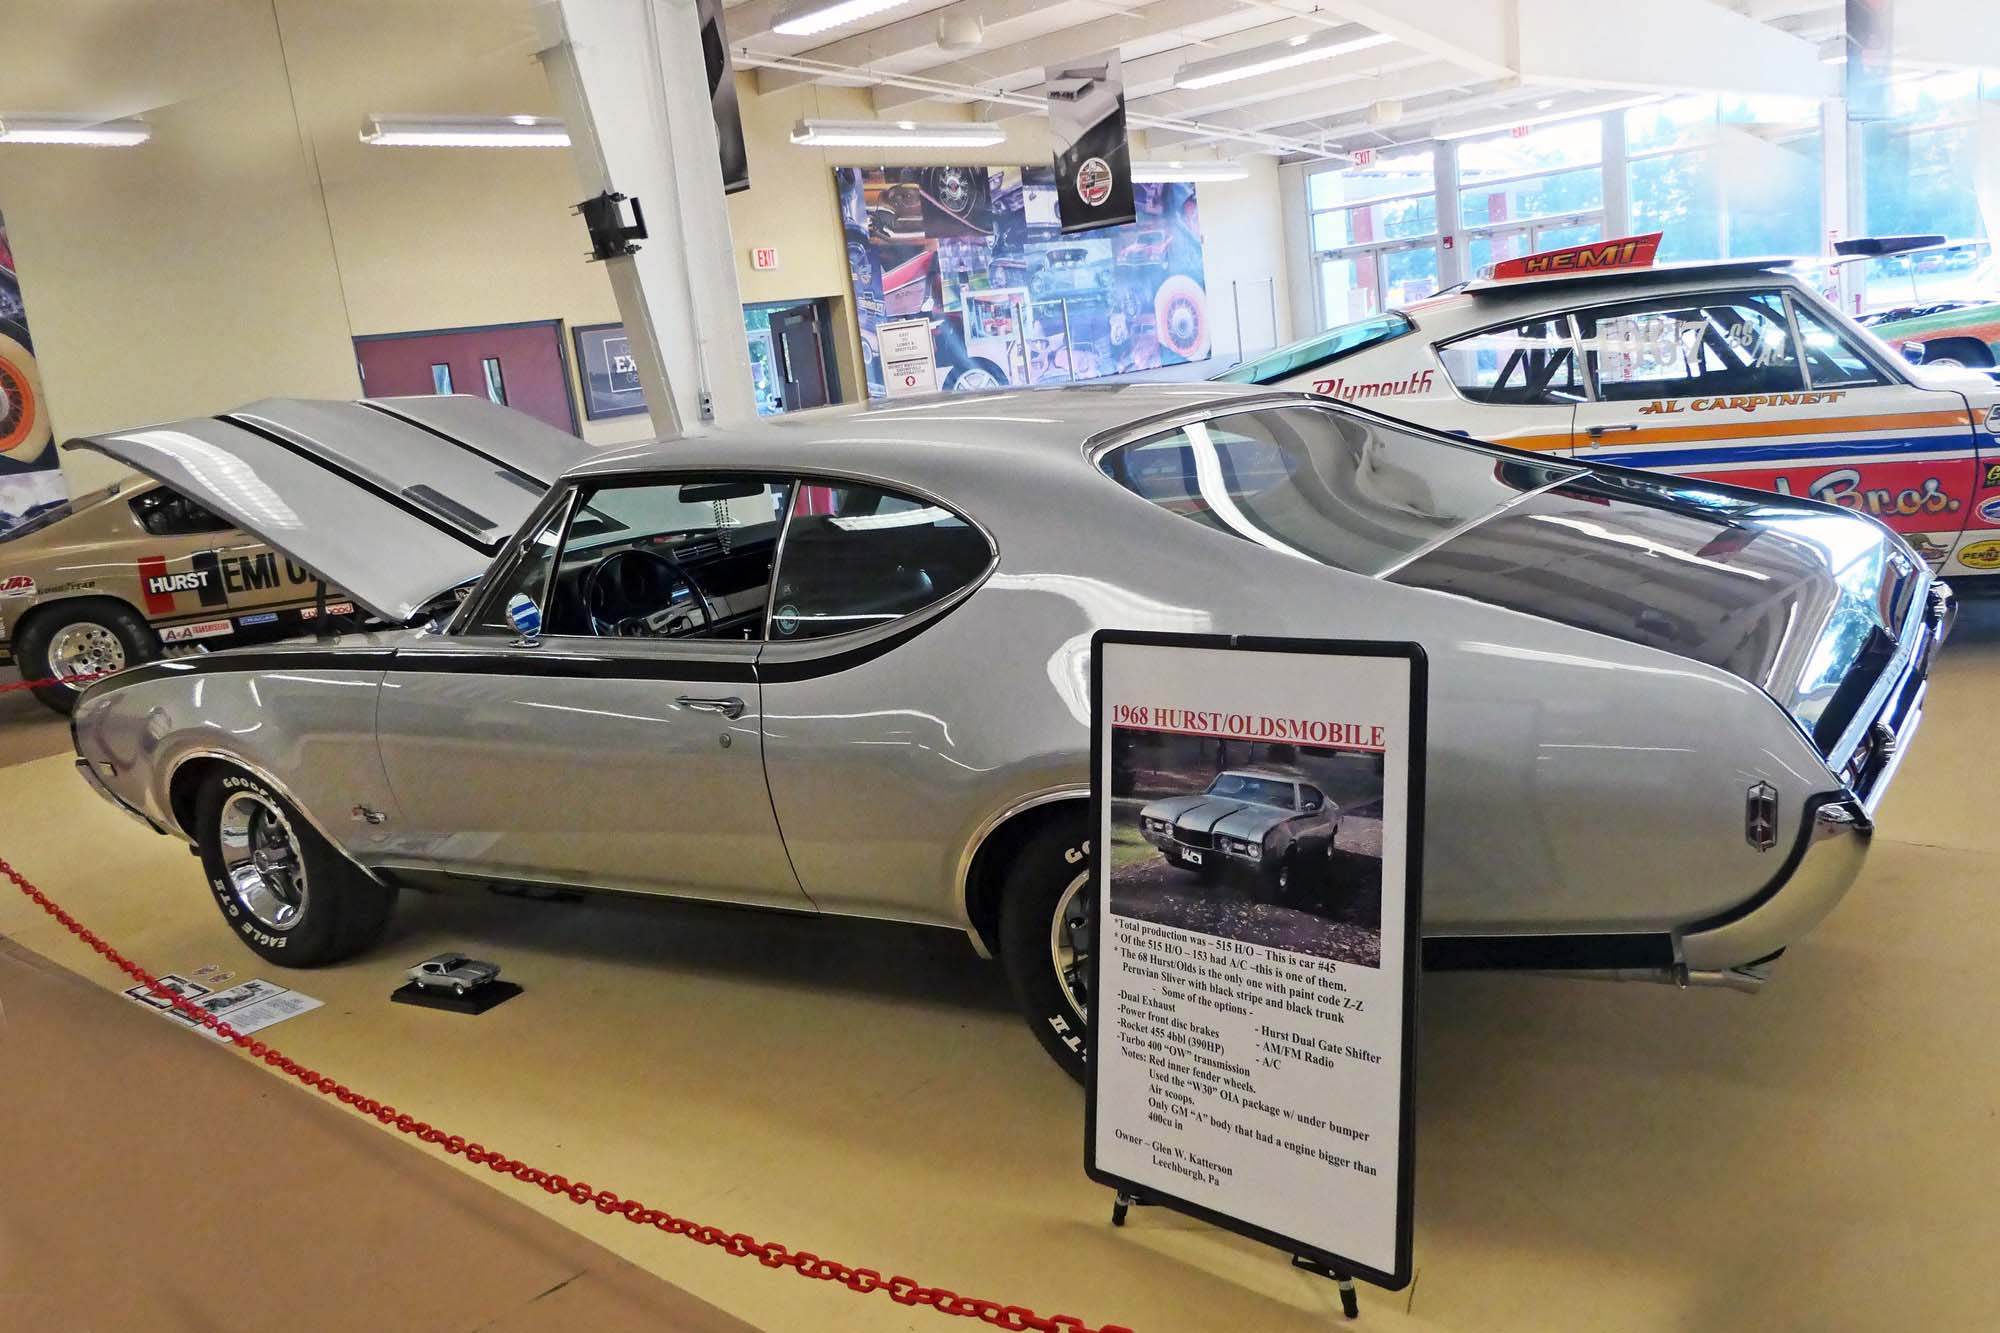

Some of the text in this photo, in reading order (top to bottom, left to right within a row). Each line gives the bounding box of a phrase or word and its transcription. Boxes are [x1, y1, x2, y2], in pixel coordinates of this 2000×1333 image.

[1354, 150, 1371, 167] EXIT
[757, 249, 775, 267] EXIT
[1312, 369, 1434, 401] Plymouth
[1638, 392, 1846, 415] AL CARPINET
[149, 570, 209, 594] HURST
[1112, 704, 1386, 746] 1968 HURST/OLDSMOBILE
[1121, 934, 1132, 944] Of
[1133, 937, 1145, 947] the
[1148, 940, 1161, 950] 515
[1165, 944, 1182, 955] H/O
[1193, 950, 1207, 961] 153
[1210, 953, 1226, 965] had
[1229, 960, 1247, 970] A/C
[1276, 967, 1282, 977] is
[1286, 972, 1302, 982] one
[1306, 976, 1316, 984] of
[1319, 977, 1347, 992] them.
[1142, 926, 1186, 942] production
[1190, 936, 1206, 946] was
[1216, 941, 1231, 951] 515
[1234, 943, 1254, 957] H/O
[1265, 950, 1285, 963] This
[1289, 955, 1296, 965] is
[1300, 959, 1315, 969] car
[1319, 962, 1336, 973] #45
[1121, 947, 1136, 959] The
[1138, 952, 1147, 961] 68
[1150, 954, 1196, 974] Hurst/Olds
[1199, 967, 1205, 976] is
[1208, 969, 1222, 979] the
[1225, 972, 1243, 986] only
[1247, 979, 1262, 988] one
[1266, 982, 1286, 994] with
[1289, 988, 1314, 1000] paint
[1318, 995, 1340, 1006] code
[1123, 962, 1158, 979] Peruvian
[1188, 979, 1206, 991] with
[1210, 982, 1233, 997] black
[1236, 991, 1263, 1005] stripe
[1266, 998, 1282, 1008] and
[1286, 1001, 1312, 1016] black
[1316, 1008, 1344, 1023] trunk
[1142, 996, 1175, 1012] Exhaust
[1162, 986, 1185, 1000] Some
[1188, 993, 1197, 1003] of
[1199, 996, 1211, 1006] the
[1214, 1002, 1246, 1015] options
[1148, 1011, 1168, 1025] front
[1171, 1018, 1187, 1030] disc
[1190, 1022, 1219, 1038] brakes
[1151, 1027, 1164, 1037] 455
[1188, 1037, 1224, 1054] (390HP)
[1262, 1025, 1288, 1041] Hurst
[1292, 1033, 1315, 1048] Dual
[1319, 1040, 1342, 1054] Gate
[1345, 1046, 1382, 1064] Shifter
[1263, 1042, 1301, 1059] AM/FM
[1305, 1052, 1334, 1068] Radio
[1121, 1046, 1256, 1093] Notes: Red inner fender wheels.
[1148, 1042, 1162, 1051] 400
[1194, 1053, 1250, 1077] transmission
[1262, 1057, 1281, 1069] A/C
[1149, 1084, 1194, 1104] Air scoops.
[1149, 1069, 1169, 1082] Used
[1172, 1076, 1185, 1087] the
[1242, 1099, 1280, 1116] package
[1283, 1110, 1295, 1119] w/
[1297, 1114, 1326, 1128] under
[1329, 1121, 1369, 1141] bumper
[1148, 1112, 1183, 1130] 400cu in
[1148, 1097, 1168, 1112] Only
[1171, 1104, 1188, 1117] GM
[1211, 1116, 1231, 1133] body
[1235, 1124, 1253, 1138] that
[1256, 1130, 1273, 1144] had
[1276, 1139, 1281, 1147] a
[1284, 1141, 1315, 1157] engine
[1319, 1149, 1350, 1167] bigger
[1353, 1161, 1376, 1176] than
[1115, 1128, 1143, 1144] Owner
[1152, 1141, 1171, 1155] Glen
[1174, 1147, 1186, 1160] W.
[1189, 1153, 1232, 1176] Katterson
[1208, 1174, 1219, 1186] Pa
